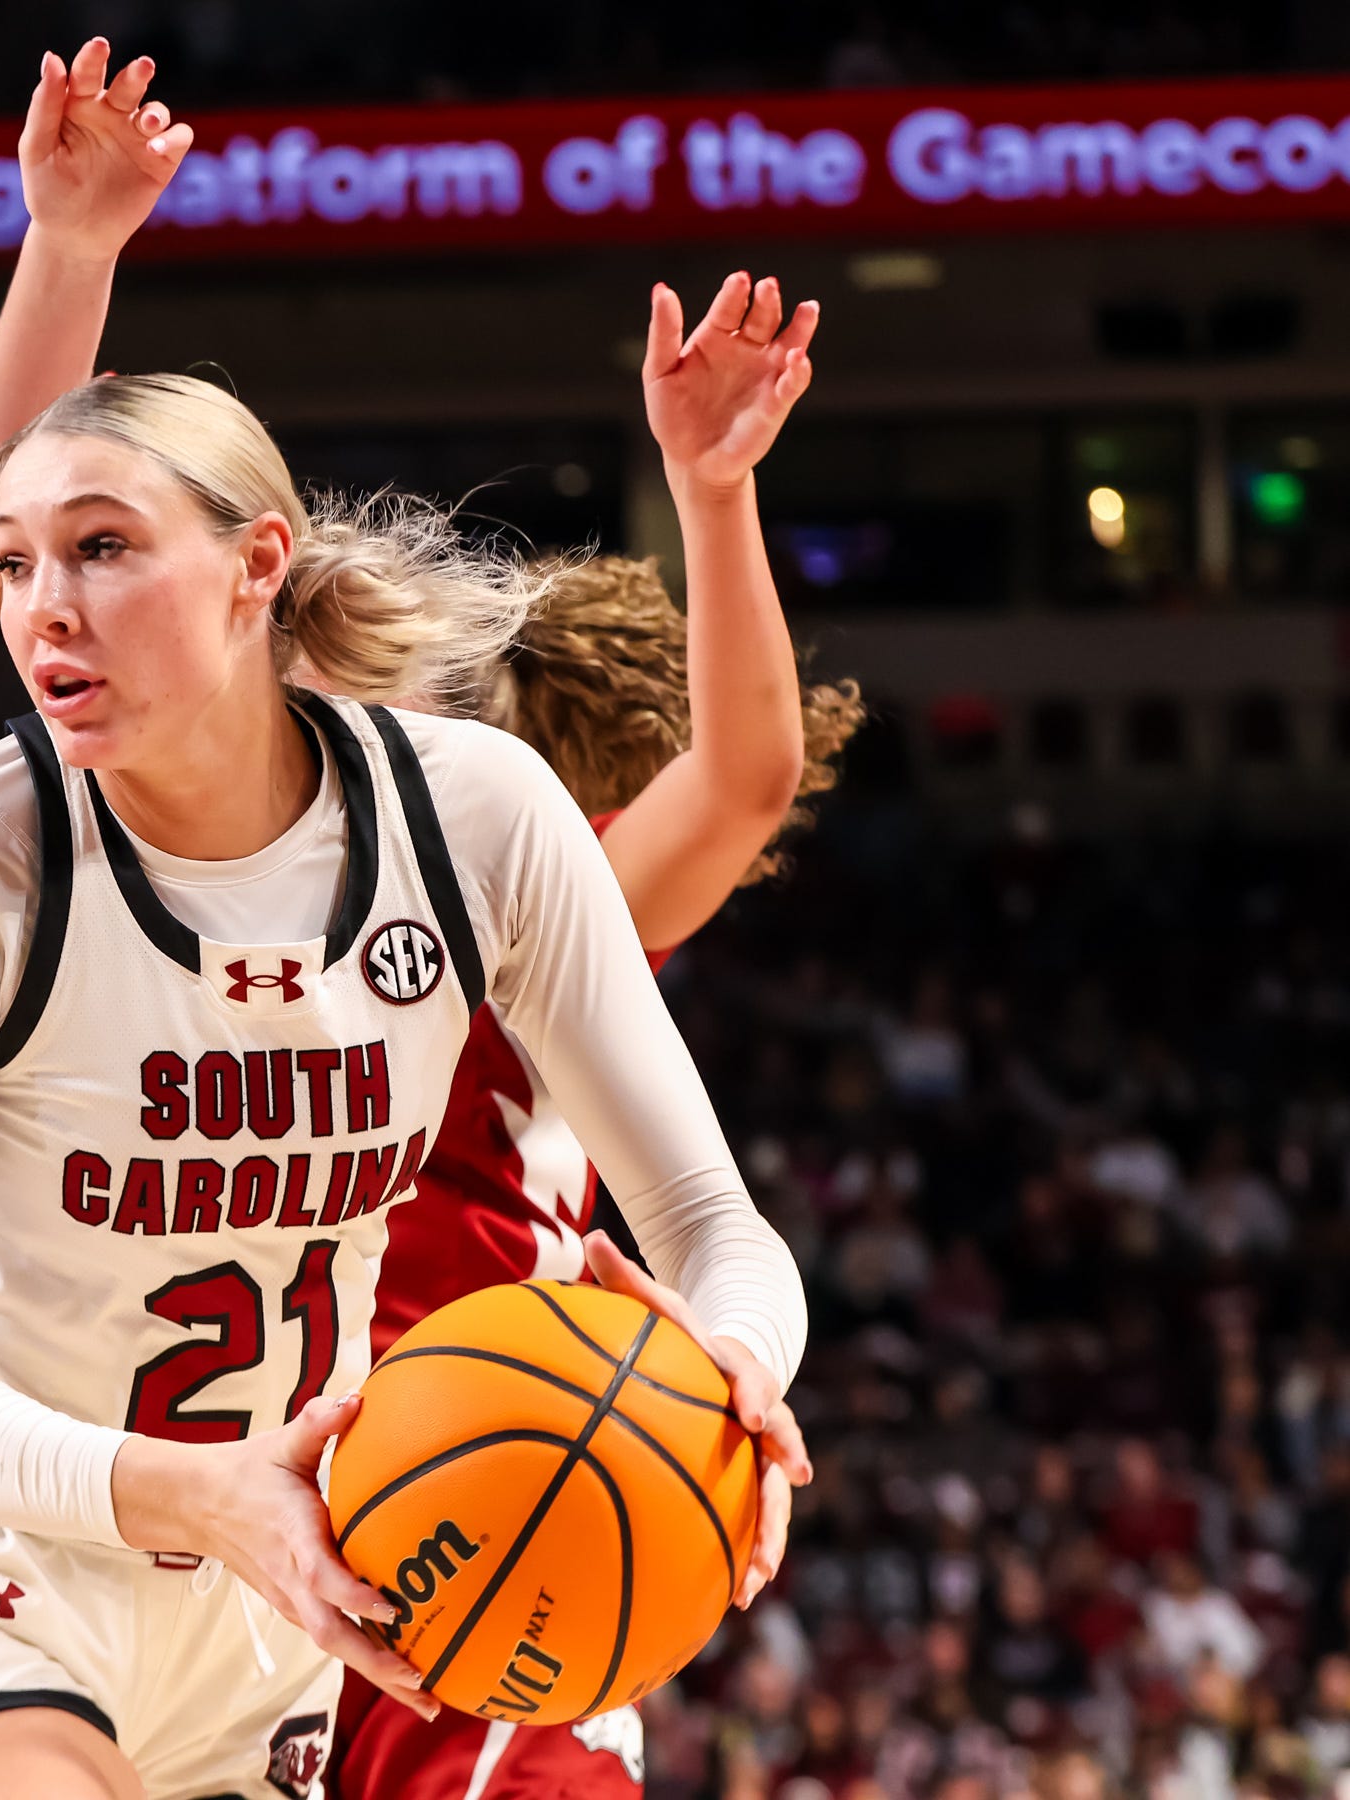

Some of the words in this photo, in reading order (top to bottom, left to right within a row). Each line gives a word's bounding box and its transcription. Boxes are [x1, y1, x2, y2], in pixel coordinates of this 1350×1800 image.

[543, 114, 668, 214] of
[682, 111, 865, 210] the
[887, 108, 1350, 203] Gameco
[369, 925, 438, 999] SEC
[140, 1039, 391, 1140] SOUTH
[62, 1127, 426, 1237] CAROLINA
[124, 1239, 340, 1440] 21
[524, 1585, 554, 1642] NXT
